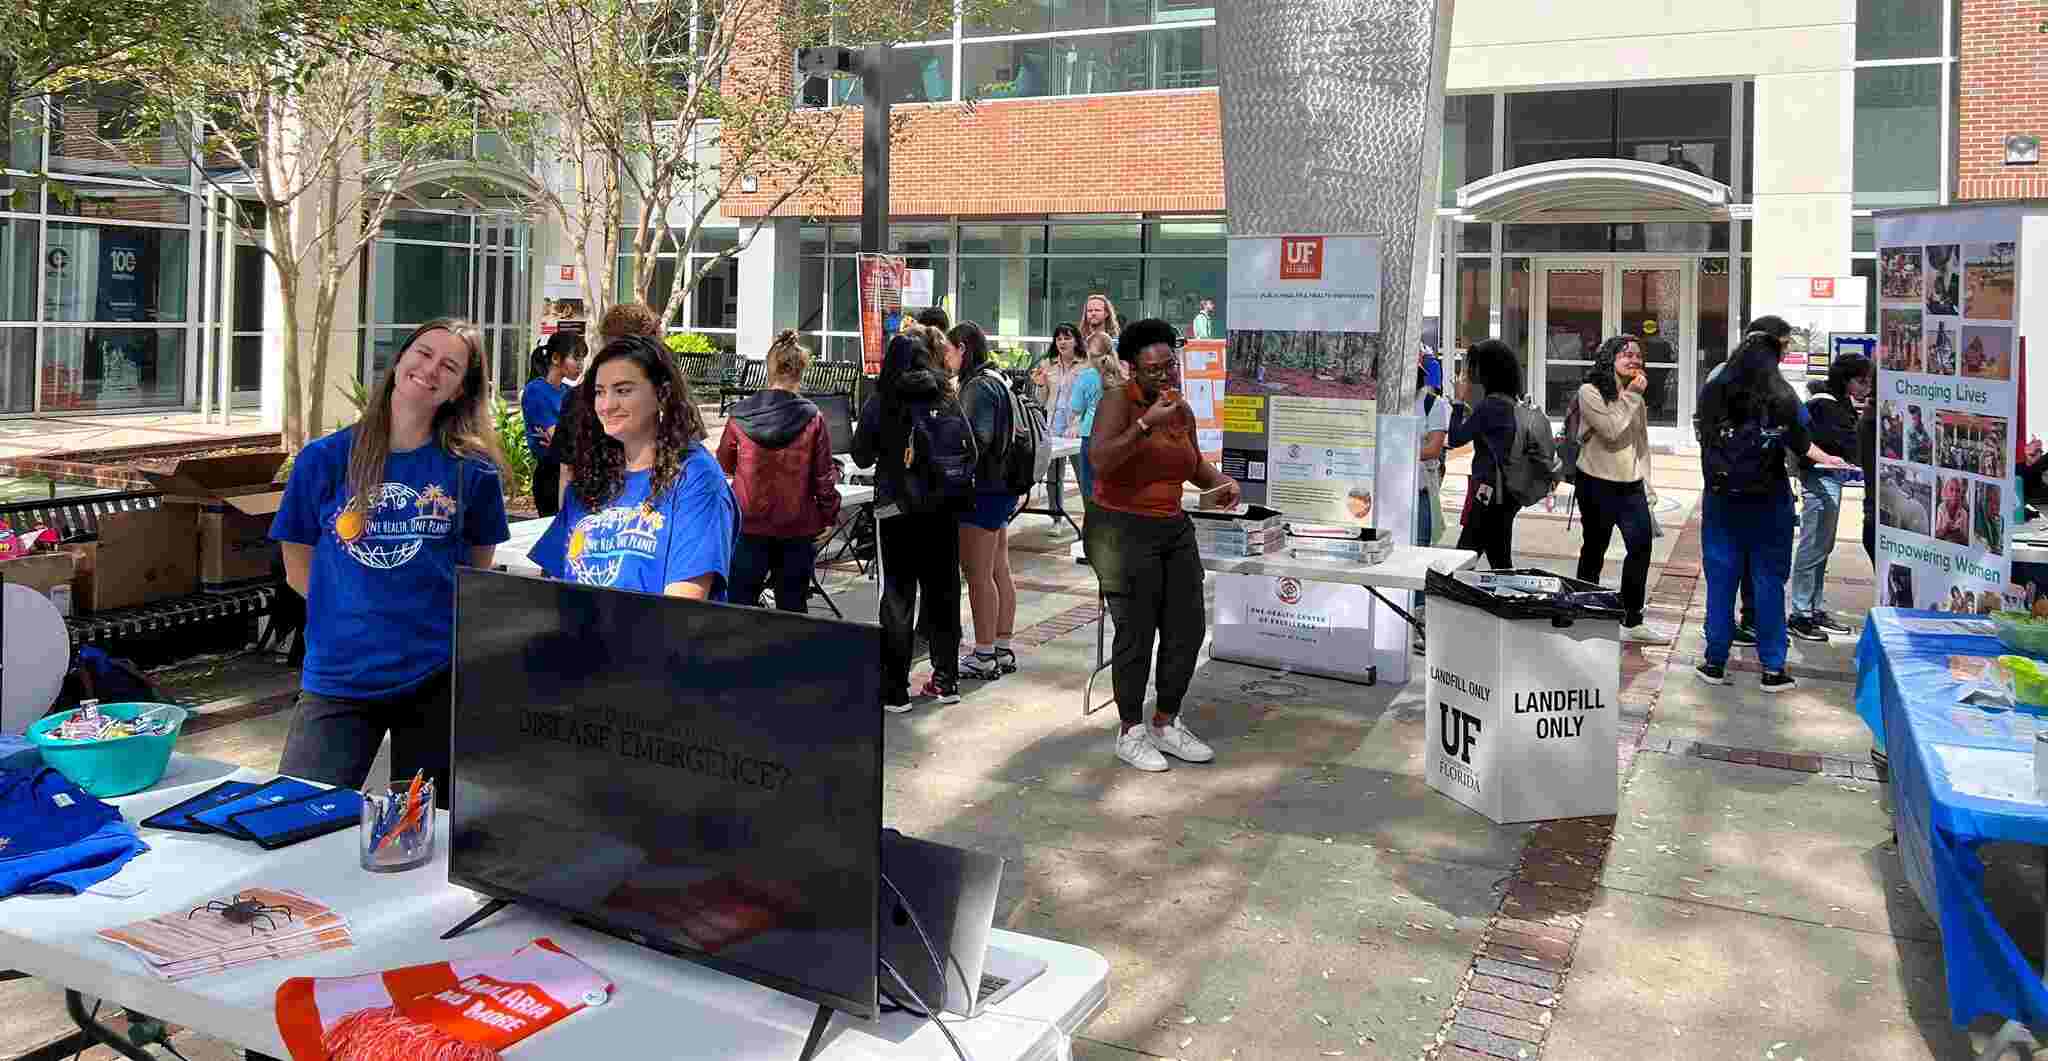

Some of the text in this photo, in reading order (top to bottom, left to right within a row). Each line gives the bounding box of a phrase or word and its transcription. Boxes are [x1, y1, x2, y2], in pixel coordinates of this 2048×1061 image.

[1287, 242, 1317, 264] UF
[1895, 379, 1988, 403] Changing Lives
[365, 519, 381, 535] ONE
[1879, 535, 2001, 584] Empowering Women
[1430, 665, 1492, 702] LANDFILL ONLY
[1514, 688, 1605, 714] LANDFILL
[1440, 702, 1481, 764] UF
[1536, 715, 1585, 740] ONLY
[1439, 760, 1481, 793] FLORIDA
